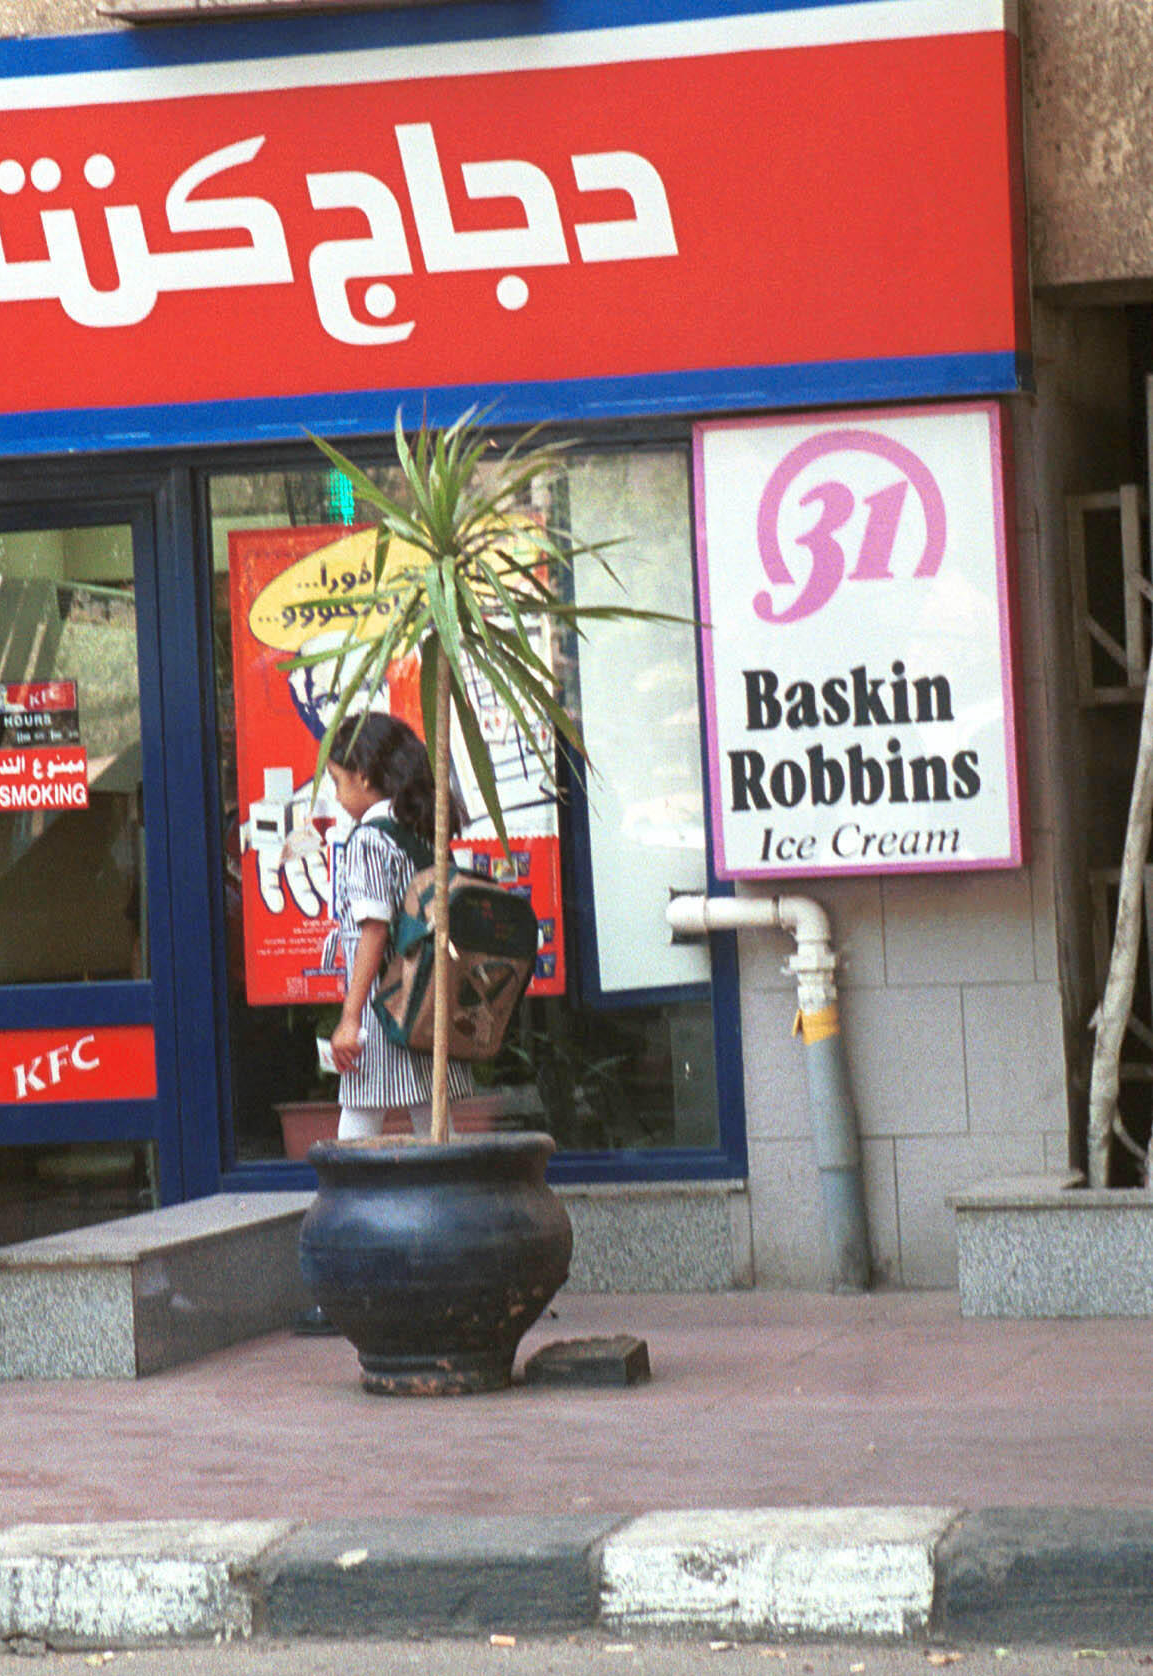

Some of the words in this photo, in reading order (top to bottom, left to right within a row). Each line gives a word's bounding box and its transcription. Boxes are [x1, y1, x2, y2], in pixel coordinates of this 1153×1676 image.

[306, 121, 680, 346] دجاج
[752, 480, 910, 626] 31
[742, 659, 955, 732] Baskin
[32, 753, 85, 780] ممنوع
[727, 737, 982, 812] Robbins
[760, 828, 817, 862] Ice
[831, 823, 960, 859] Cream
[12, 1032, 101, 1100] KFC
